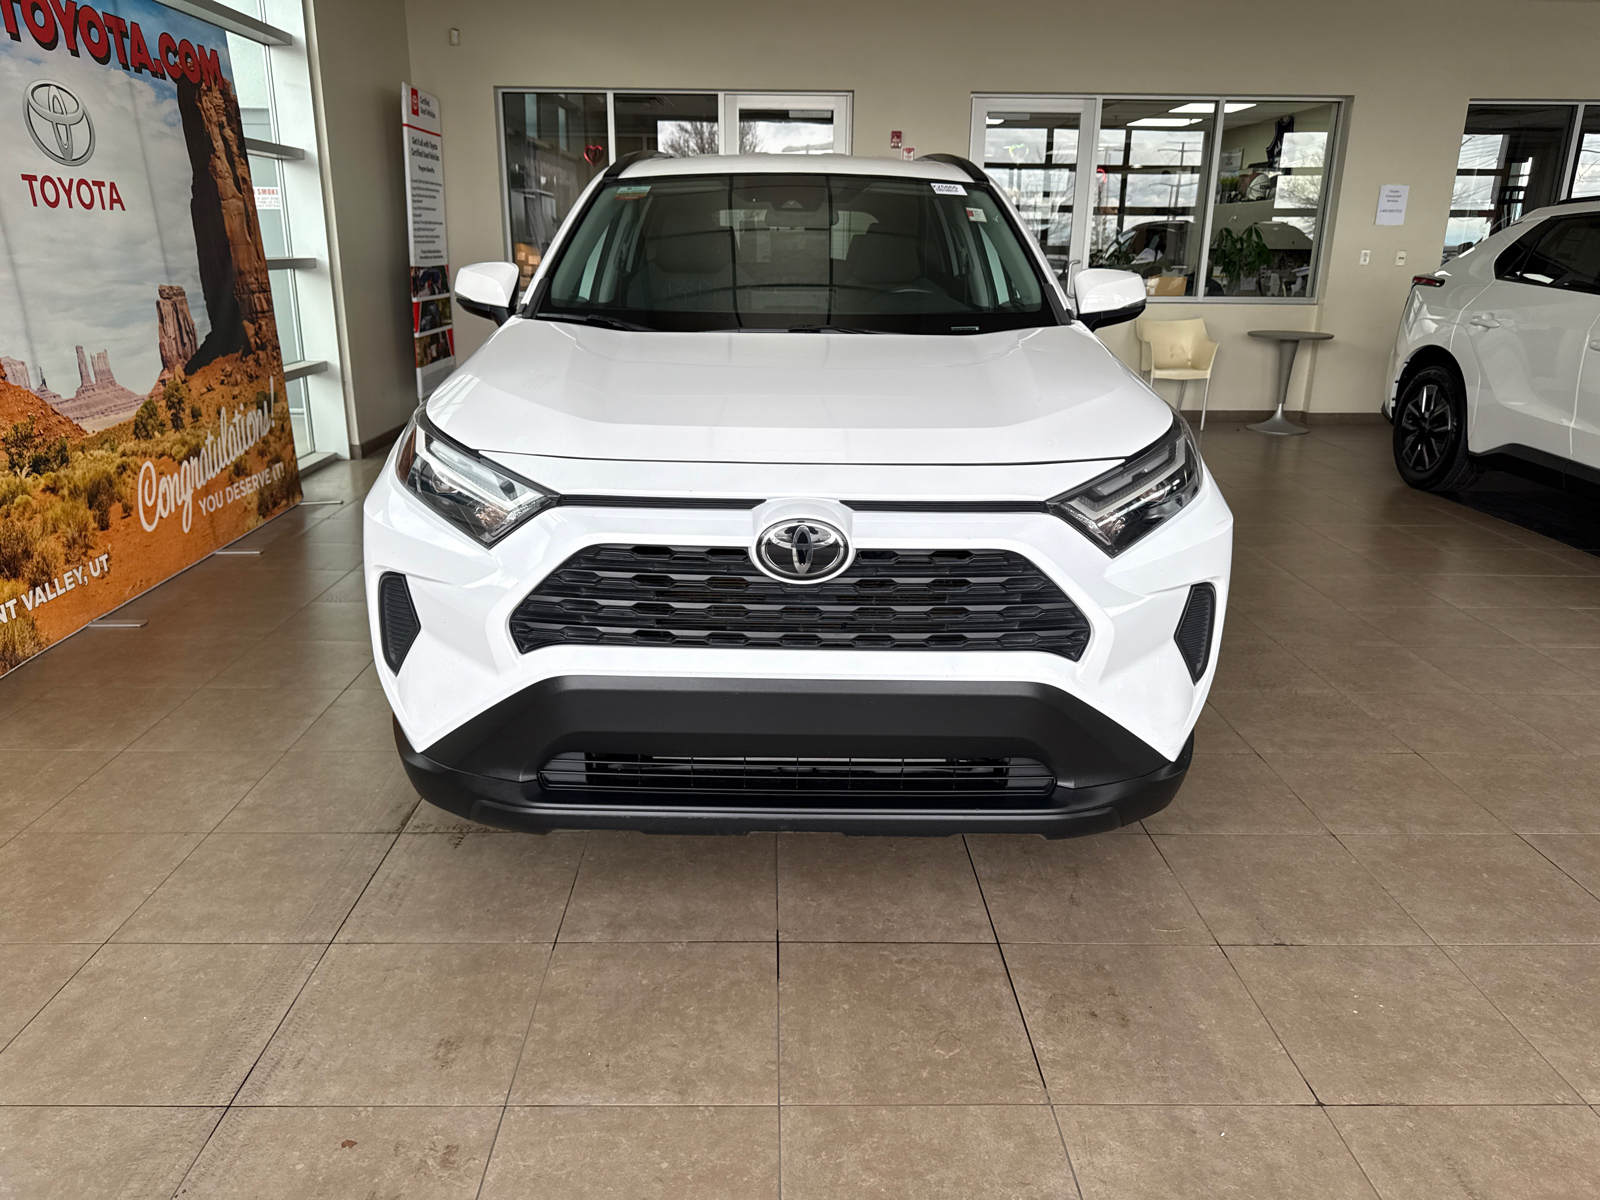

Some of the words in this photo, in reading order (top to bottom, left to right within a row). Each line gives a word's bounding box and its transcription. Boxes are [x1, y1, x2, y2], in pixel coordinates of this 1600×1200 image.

[20, 173, 126, 212] TOYOTA
[138, 375, 276, 534] Congratulations!
[198, 490, 224, 516] YOU
[225, 468, 272, 504] DESERVE
[271, 461, 285, 481] IT!
[20, 566, 88, 612] VALLEY,
[89, 554, 109, 578] UT
